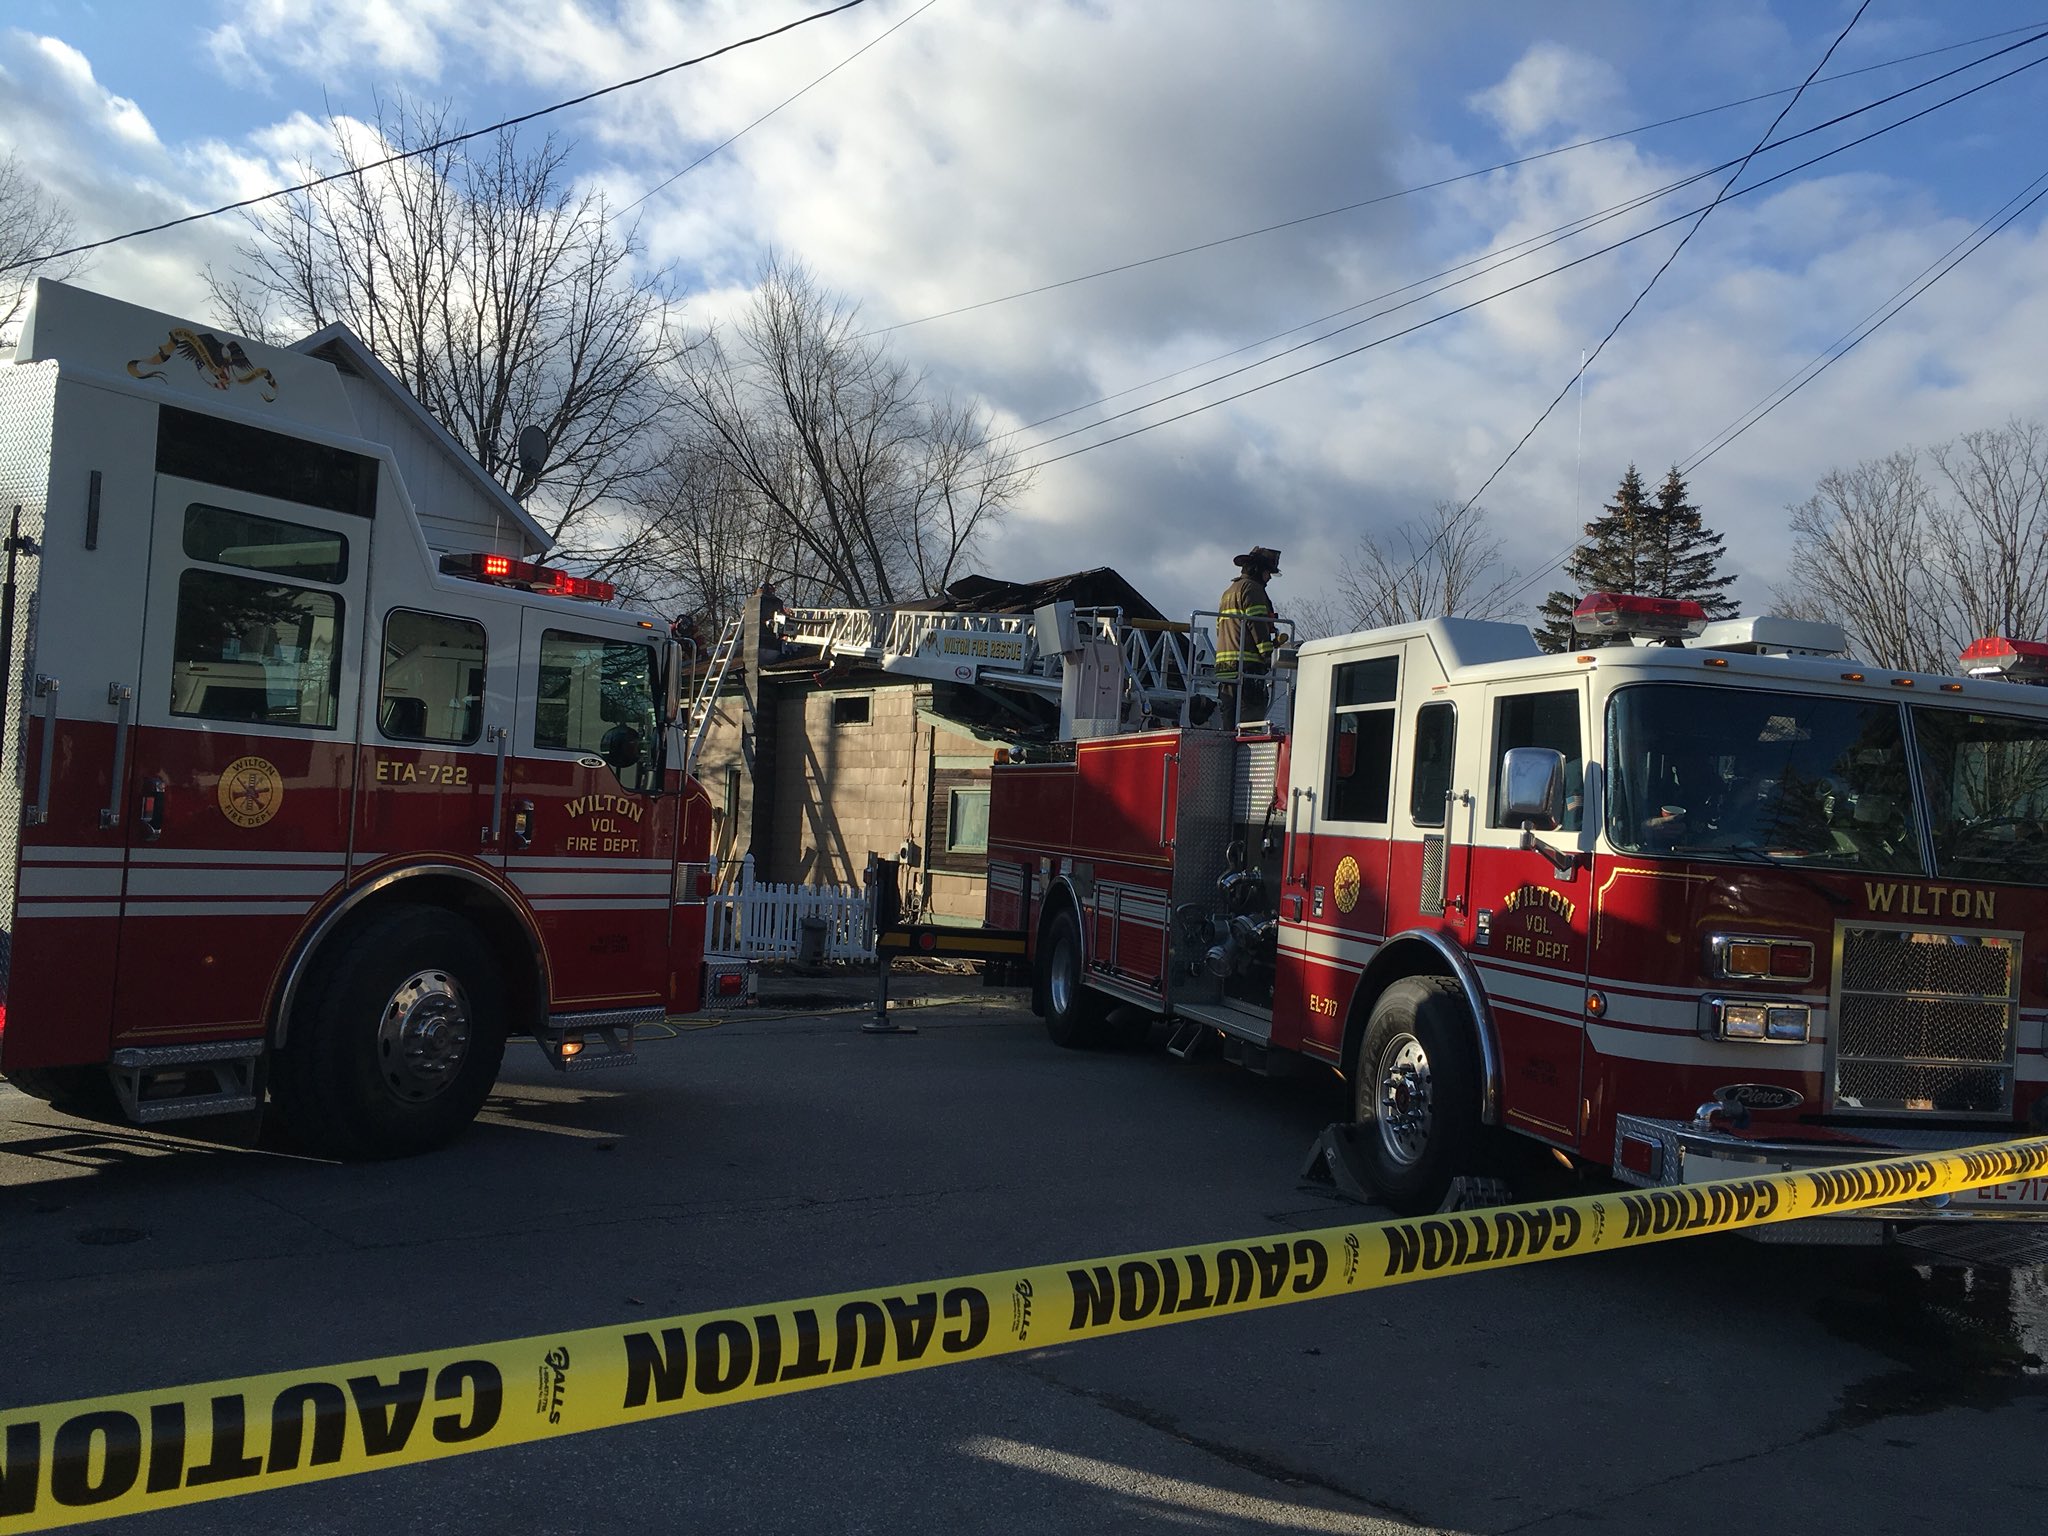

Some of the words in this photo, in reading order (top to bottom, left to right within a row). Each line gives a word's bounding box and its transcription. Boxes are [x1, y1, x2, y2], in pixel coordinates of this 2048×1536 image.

[943, 637, 970, 656] WILTON
[971, 639, 989, 658] FIRE
[990, 640, 1022, 661] RESCUE
[232, 759, 275, 776] WILTON
[376, 760, 468, 785] ETA-722
[225, 804, 244, 823] FIRE
[564, 794, 644, 823] WILTON
[591, 818, 621, 833] VOL.
[567, 837, 597, 851] FIRE
[603, 838, 639, 852] DEPT.
[1504, 885, 1576, 923] WILTON
[1865, 882, 1996, 920] WILTON
[1526, 914, 1553, 935] VOL.
[1505, 934, 1531, 954] FIRE
[1536, 940, 1570, 962] DEPT.
[1310, 994, 1338, 1018] EL-717
[1735, 1087, 1784, 1104] Pierce
[1958, 1144, 2048, 1182] AUTION
[1810, 1161, 1937, 1207] CAUTION
[1621, 1180, 1779, 1239] CAUTION
[1381, 1205, 1582, 1277] CAUTION
[1066, 1238, 1329, 1331] CAUTION
[1015, 1279, 1033, 1342] GALLS
[623, 1286, 990, 1409] CAUTION
[544, 1345, 570, 1425] GALLS
